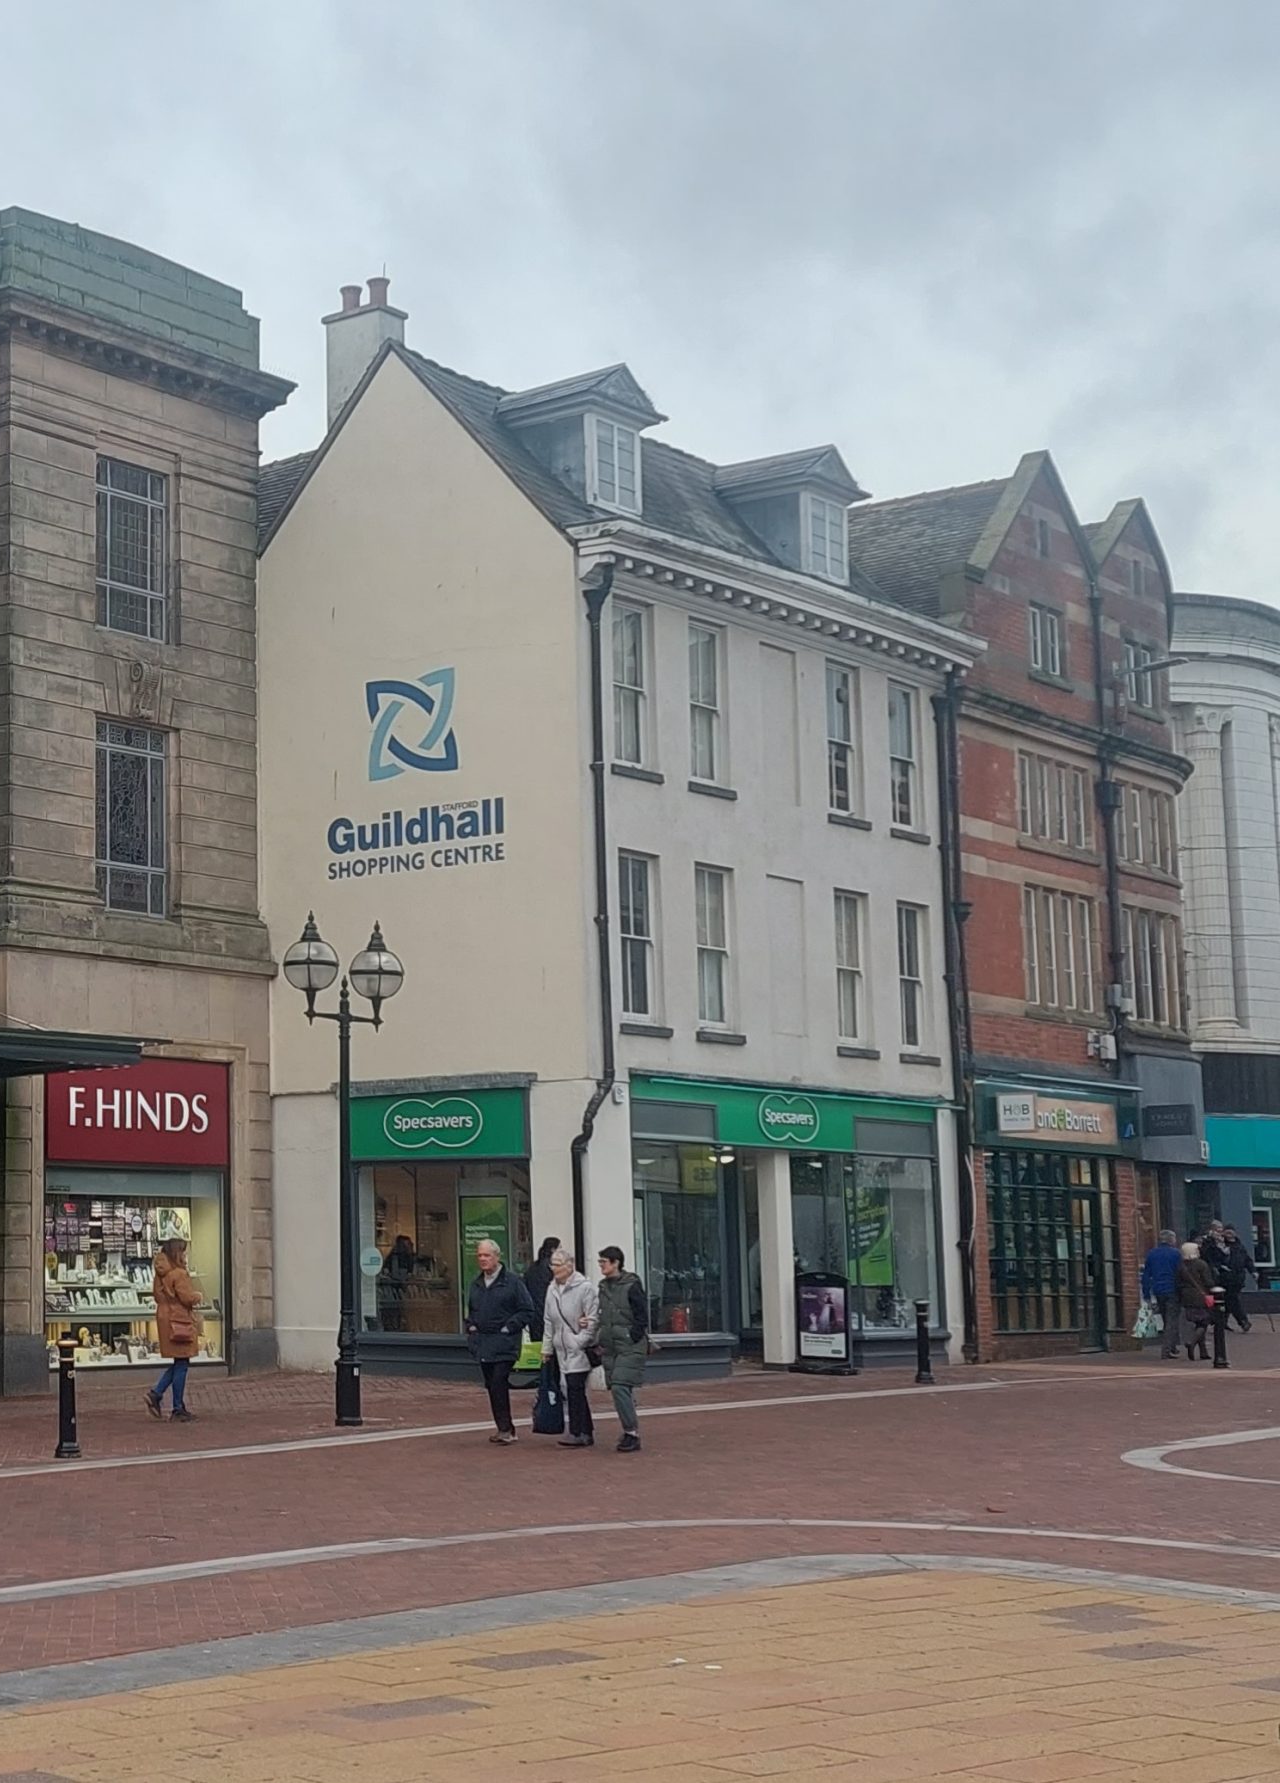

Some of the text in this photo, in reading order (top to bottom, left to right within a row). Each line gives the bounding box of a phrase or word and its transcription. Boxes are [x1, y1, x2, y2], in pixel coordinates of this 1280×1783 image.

[441, 800, 479, 812] STAFFORD
[327, 797, 505, 855] Guildhall
[327, 842, 505, 880] SHOPPING CENTRE
[69, 1086, 209, 1134] F.HINDS
[393, 1115, 474, 1132] Specsavers
[765, 1108, 814, 1126] Specsavers
